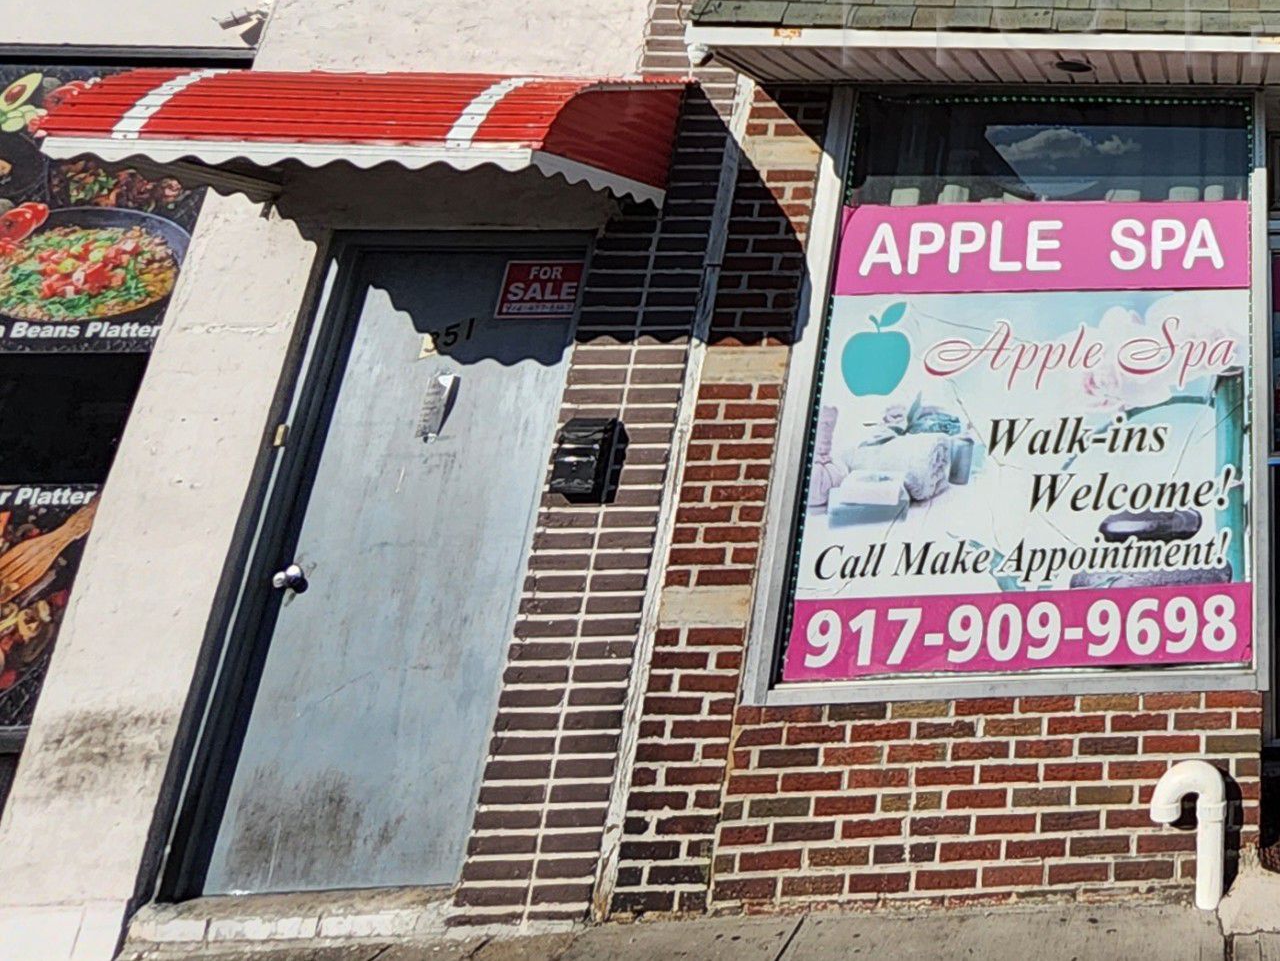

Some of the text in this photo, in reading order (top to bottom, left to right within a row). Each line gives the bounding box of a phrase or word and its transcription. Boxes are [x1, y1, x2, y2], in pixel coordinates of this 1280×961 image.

[859, 218, 1224, 276] APPLE SPA
[507, 282, 578, 301] SALE
[529, 266, 563, 280] FOR
[10, 322, 80, 338] Beans
[85, 322, 162, 338] Platter
[924, 317, 1235, 390] Apple Spa
[987, 417, 1167, 456] Walk-ins
[14, 488, 97, 505] Platter
[1030, 469, 1231, 513] Welcome!
[814, 532, 1228, 583] Call Make Appointment!
[804, 594, 1237, 668] 917-909-9698
